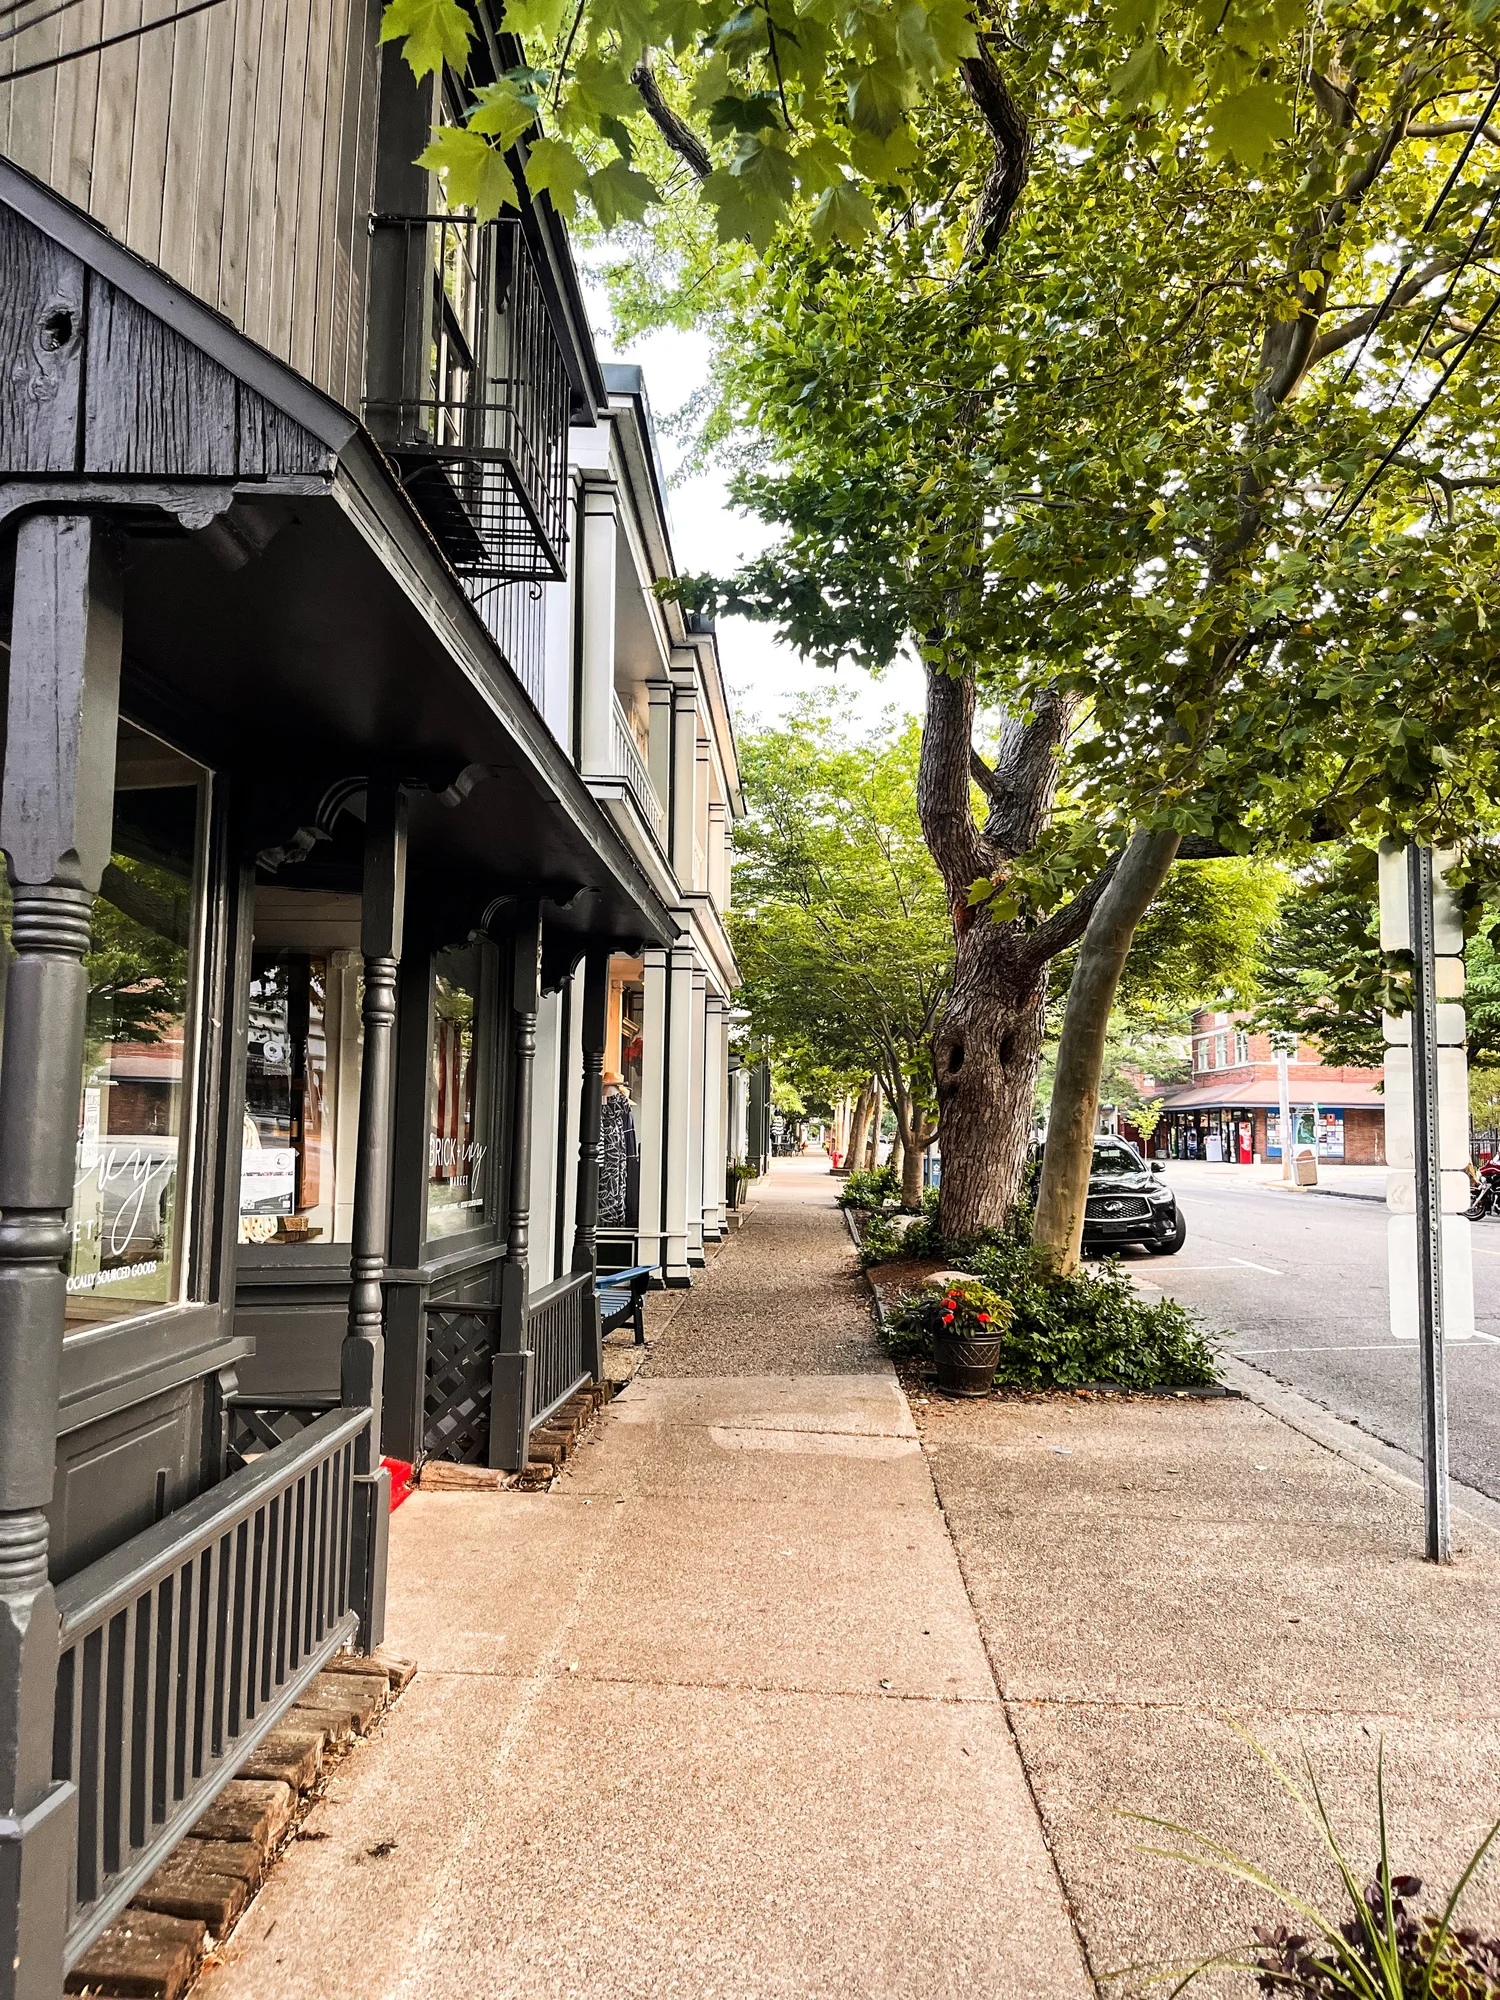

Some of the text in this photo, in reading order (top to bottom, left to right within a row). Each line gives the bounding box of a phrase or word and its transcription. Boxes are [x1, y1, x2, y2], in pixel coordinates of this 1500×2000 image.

[429, 1136, 456, 1167] BRICK
[66, 1260, 157, 1291] OCALLY SOURCED GOODS
